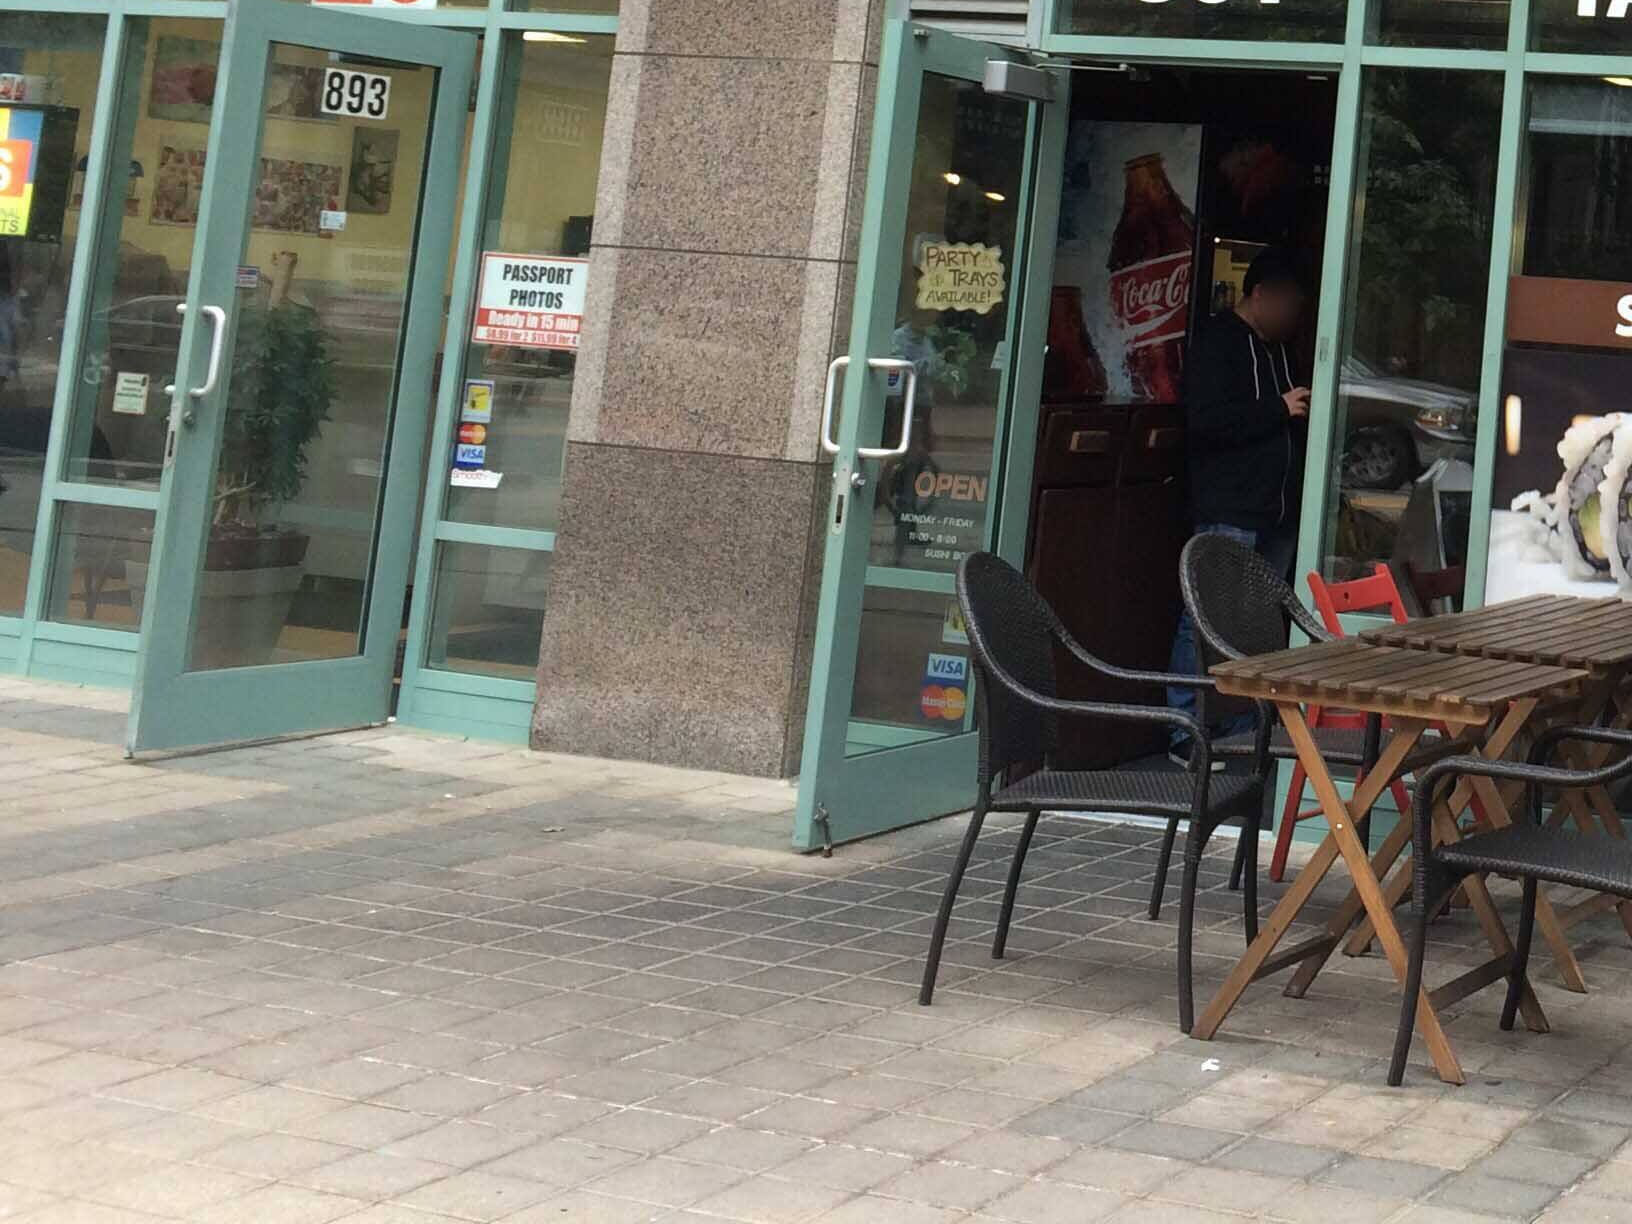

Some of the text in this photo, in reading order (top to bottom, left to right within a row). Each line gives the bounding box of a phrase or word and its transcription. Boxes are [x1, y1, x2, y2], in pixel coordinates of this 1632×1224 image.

[325, 71, 387, 117] 893
[926, 246, 981, 267] PARTY
[503, 264, 573, 285] PASSPORT
[949, 269, 999, 287] TRAYS
[509, 289, 563, 309] PHOTOS
[926, 289, 991, 303] AVAILABLE!
[488, 310, 525, 329] Ready
[541, 314, 554, 330] 15
[555, 316, 579, 332] min
[460, 447, 484, 459] VISA
[915, 471, 987, 502] OPEN
[900, 513, 936, 525] MONDAY
[943, 517, 975, 529] FRIDAY
[931, 658, 963, 675] VISA
